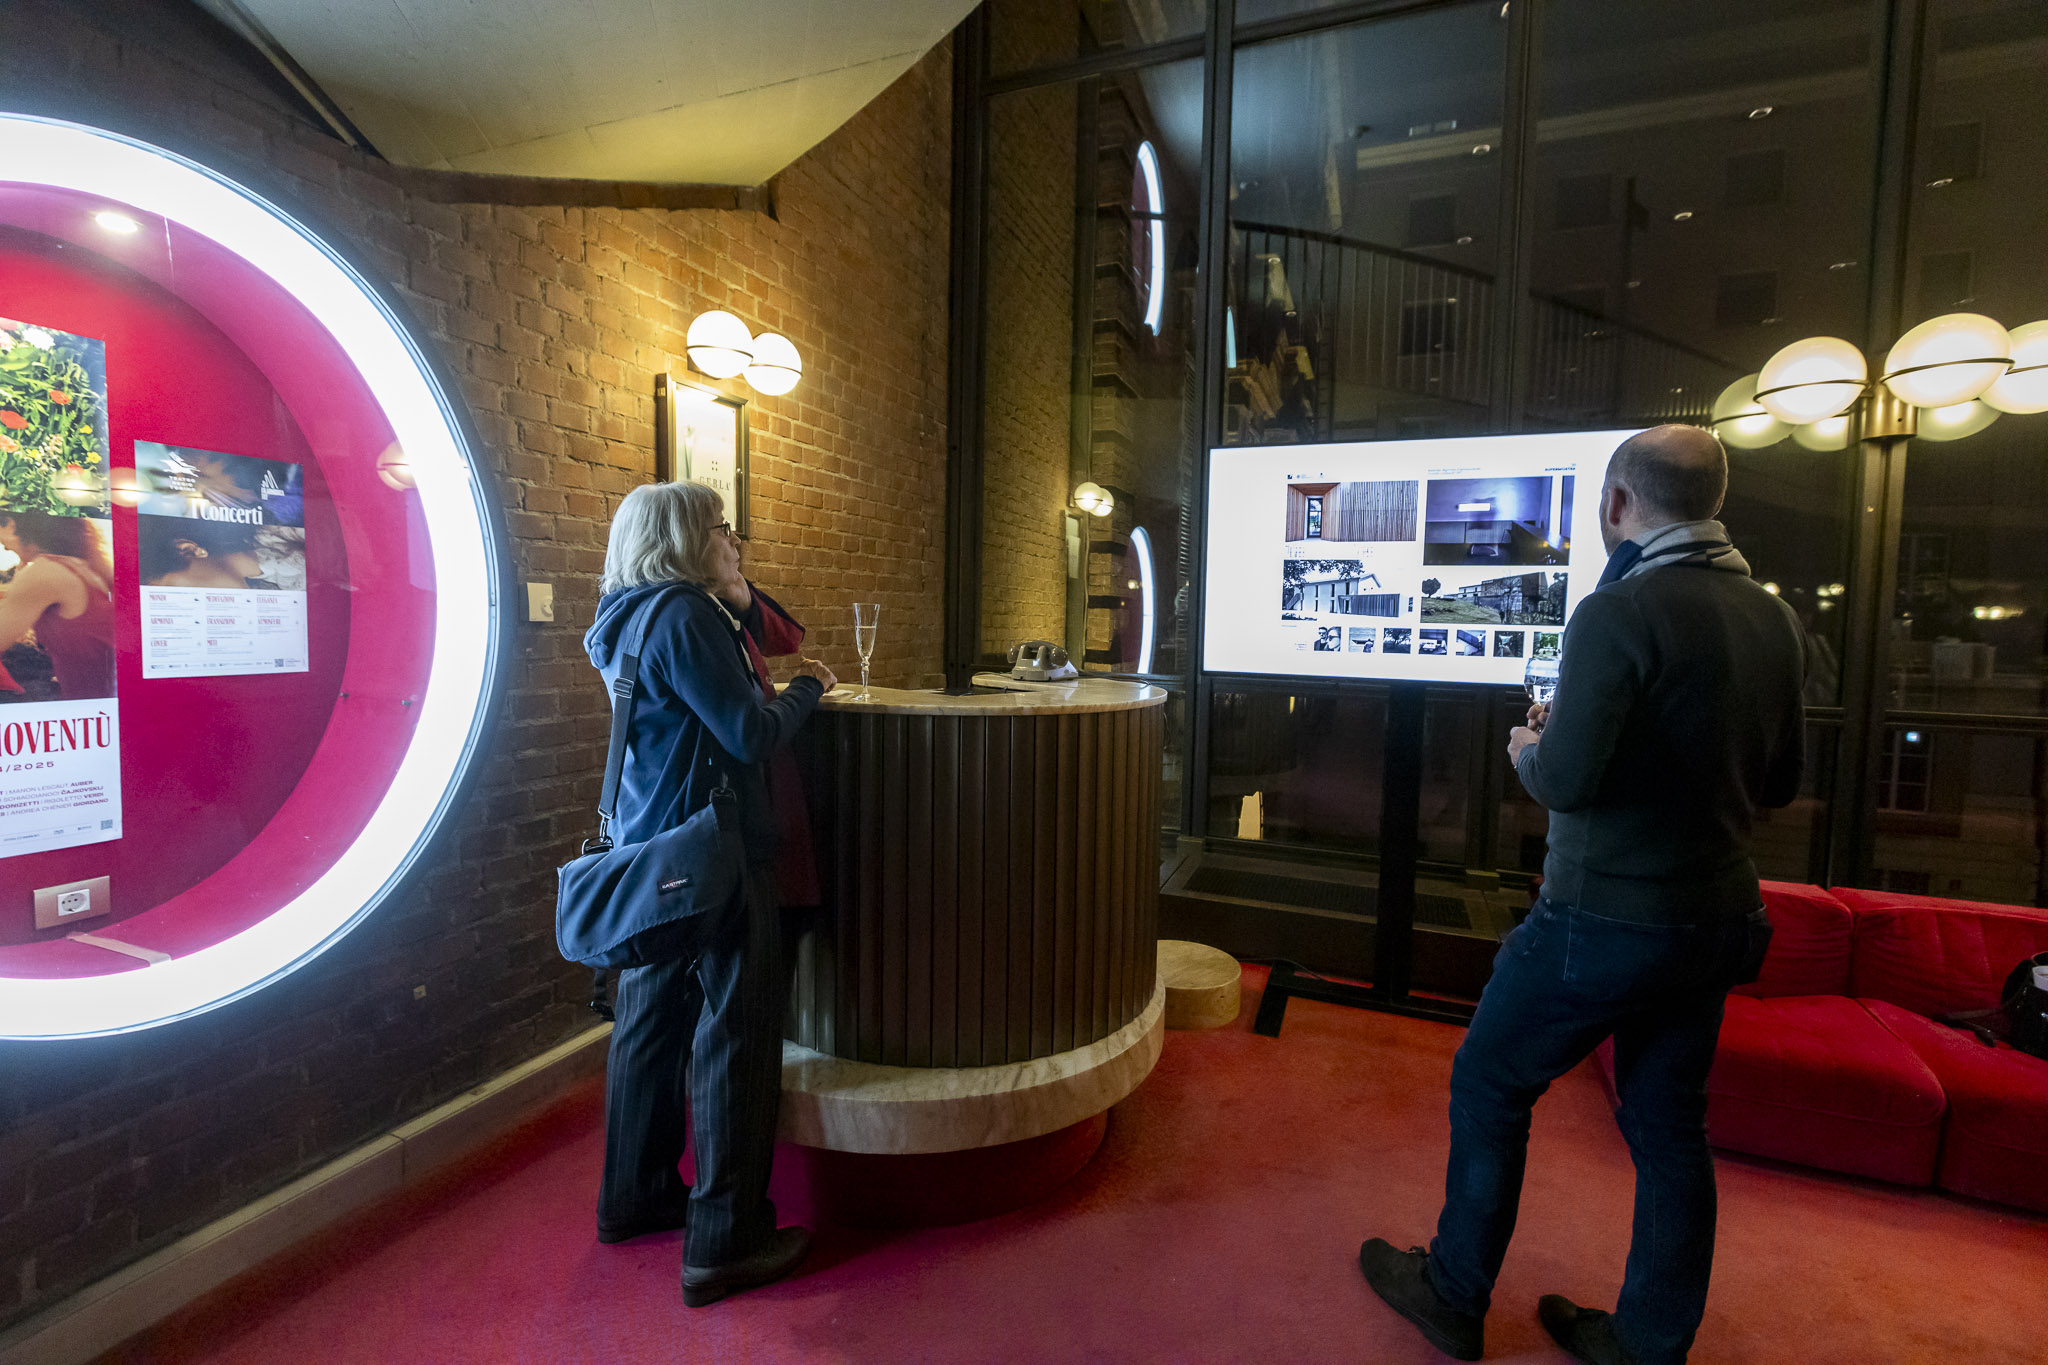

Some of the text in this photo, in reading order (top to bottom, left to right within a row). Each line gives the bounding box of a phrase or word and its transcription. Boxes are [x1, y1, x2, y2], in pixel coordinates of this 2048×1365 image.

[200, 499, 263, 525] Concerti
[0, 710, 110, 757] OVENTÙ
[70, 780, 93, 788] AUBER
[0, 800, 40, 810] DONIZETTI
[83, 791, 104, 799] VERDI
[73, 798, 109, 807] GIORDANO
